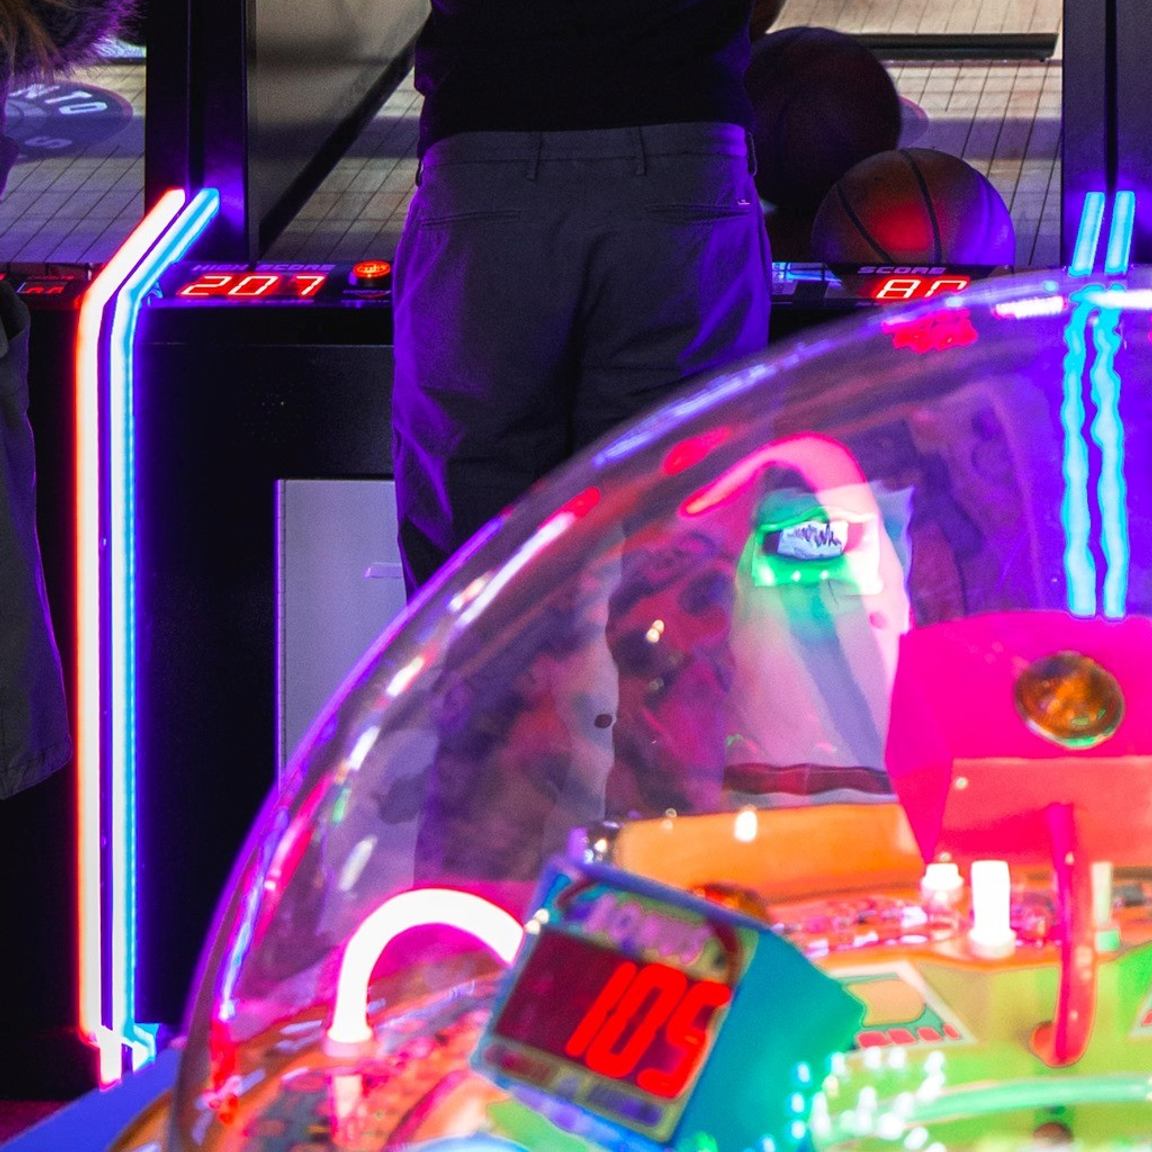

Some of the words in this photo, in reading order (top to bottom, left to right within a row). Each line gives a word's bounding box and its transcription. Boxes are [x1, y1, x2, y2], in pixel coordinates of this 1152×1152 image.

[192, 263, 249, 272] HIGH
[255, 263, 337, 272] SCORE
[856, 266, 947, 275] SCORE
[179, 274, 327, 297] 207
[564, 961, 733, 1101] 105
